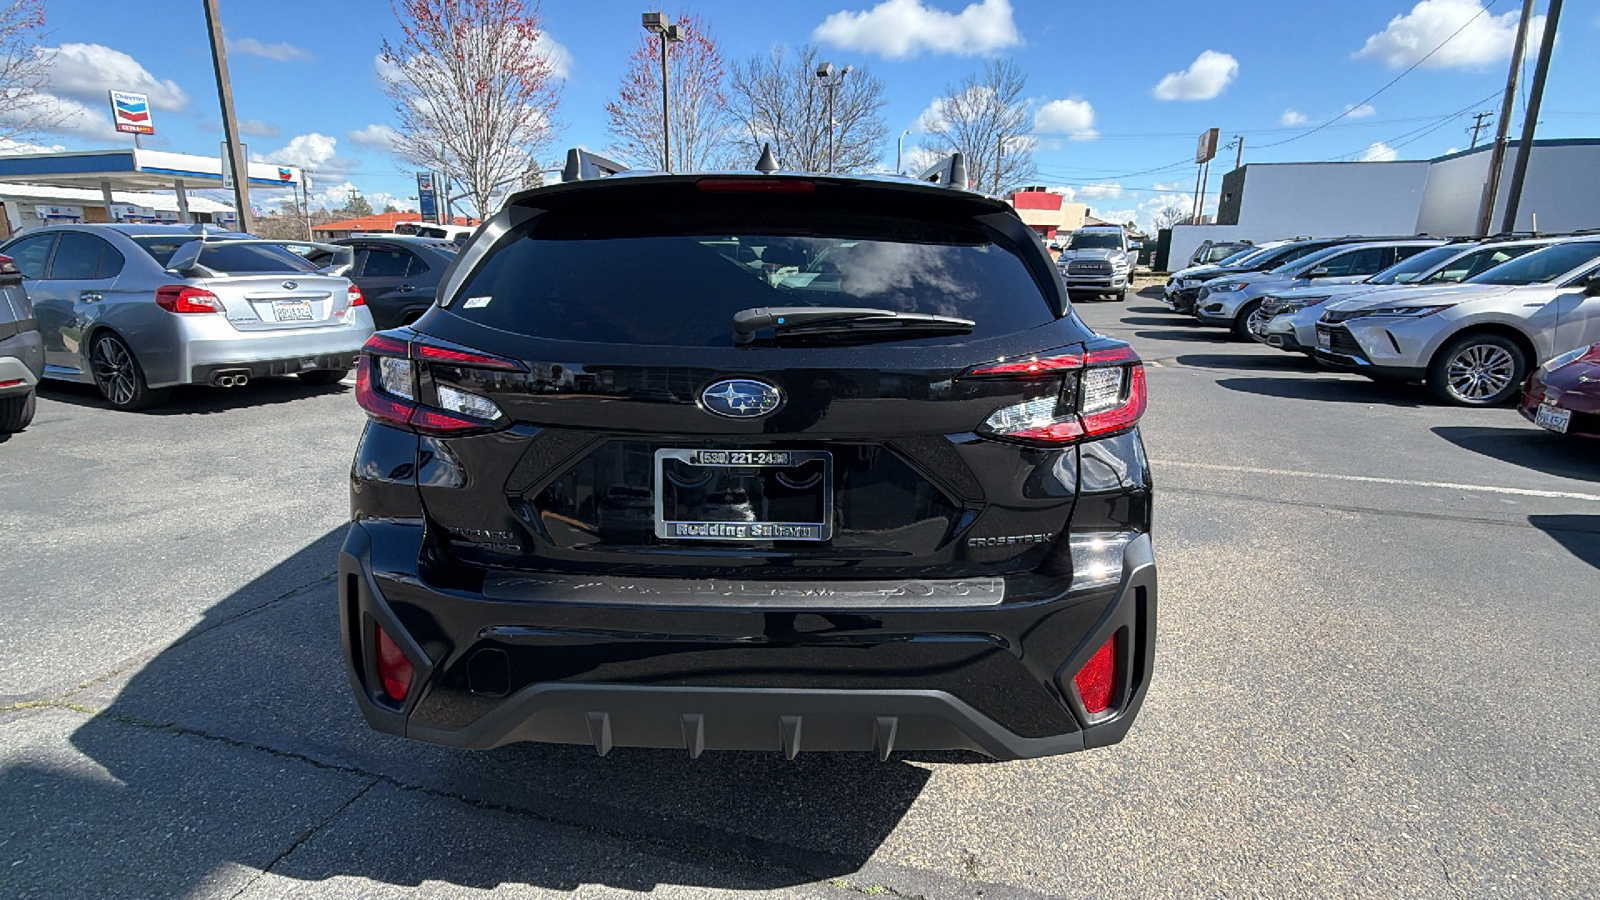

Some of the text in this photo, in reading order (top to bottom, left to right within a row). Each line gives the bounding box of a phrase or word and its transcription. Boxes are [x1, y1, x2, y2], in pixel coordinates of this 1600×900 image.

[114, 93, 146, 102] Chevron
[700, 451, 729, 464] (530)
[448, 526, 514, 539] SUBARU
[676, 523, 812, 538] Redding Subaru
[967, 532, 1053, 547] CROSSTREK
